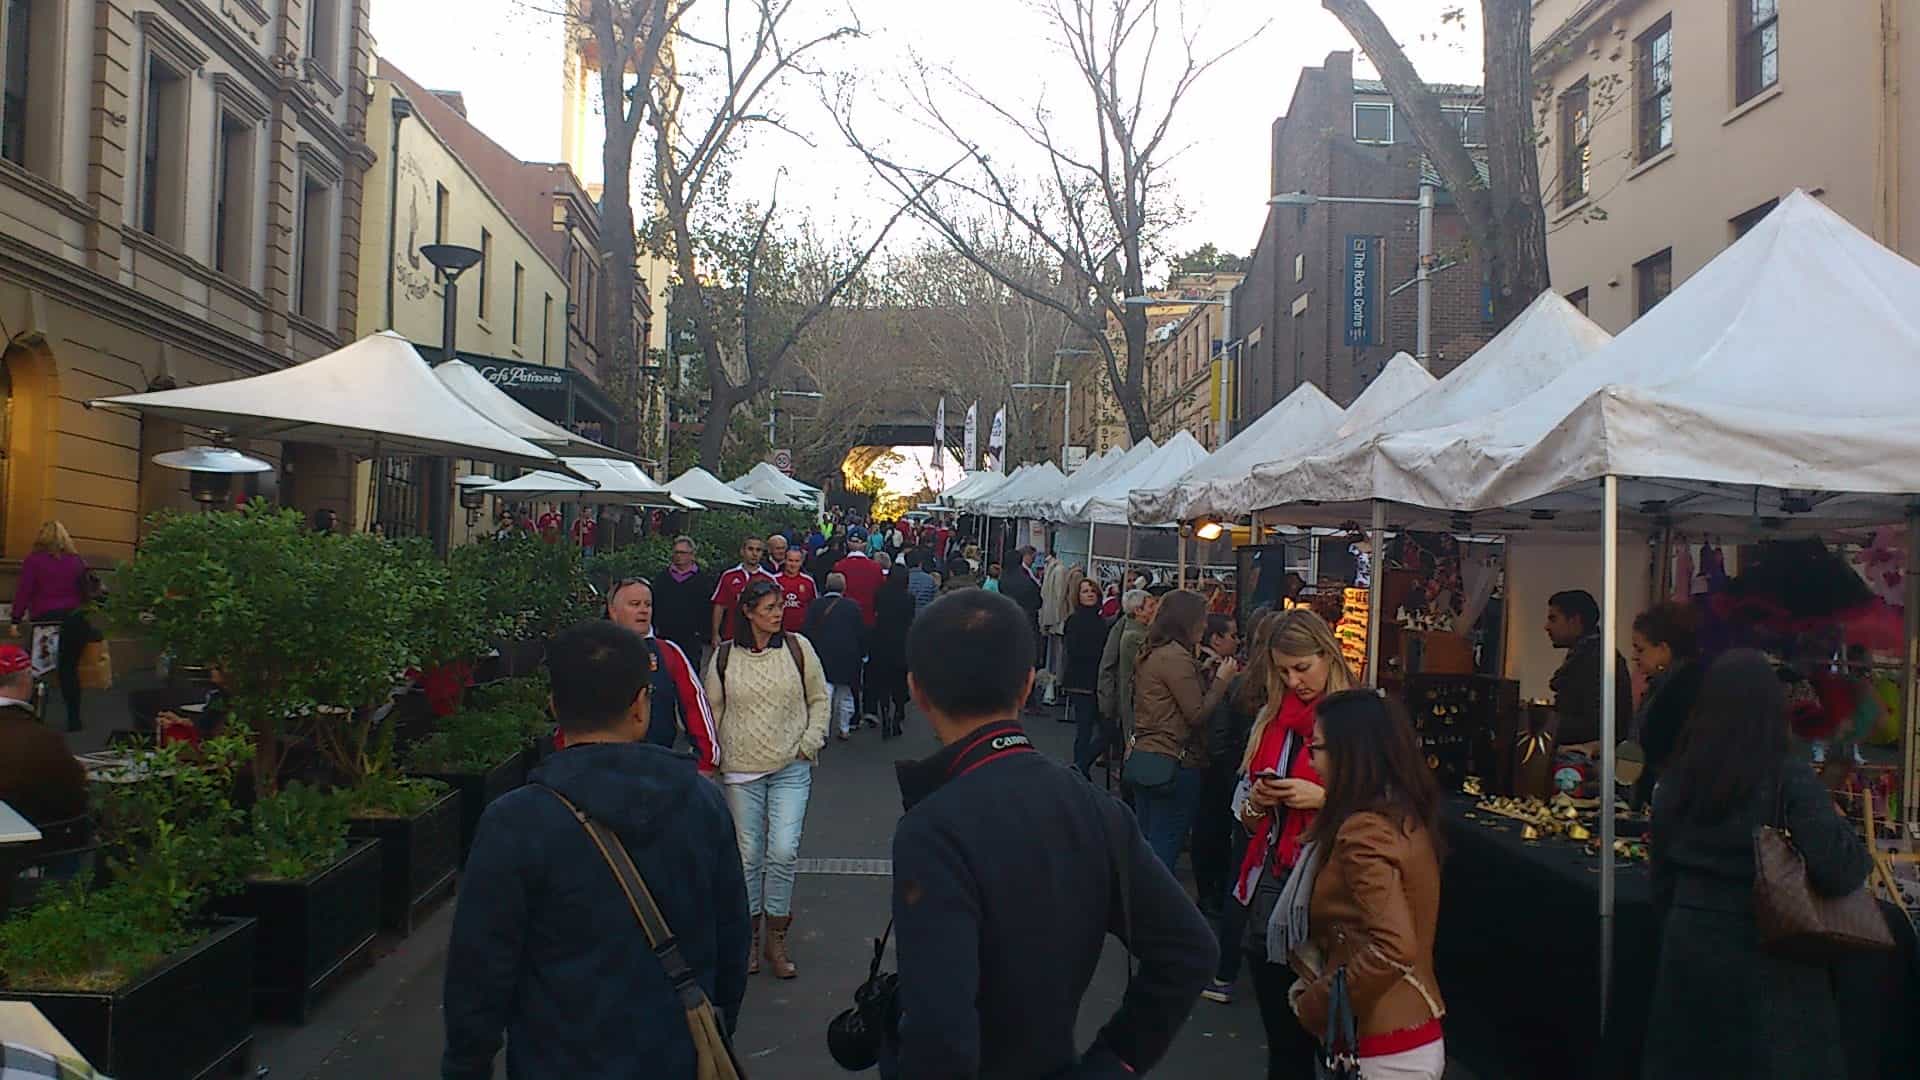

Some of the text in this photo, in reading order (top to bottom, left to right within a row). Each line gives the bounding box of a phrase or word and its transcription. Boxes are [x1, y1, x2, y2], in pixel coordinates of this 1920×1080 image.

[1353, 252, 1366, 328] The Rocks Centre
